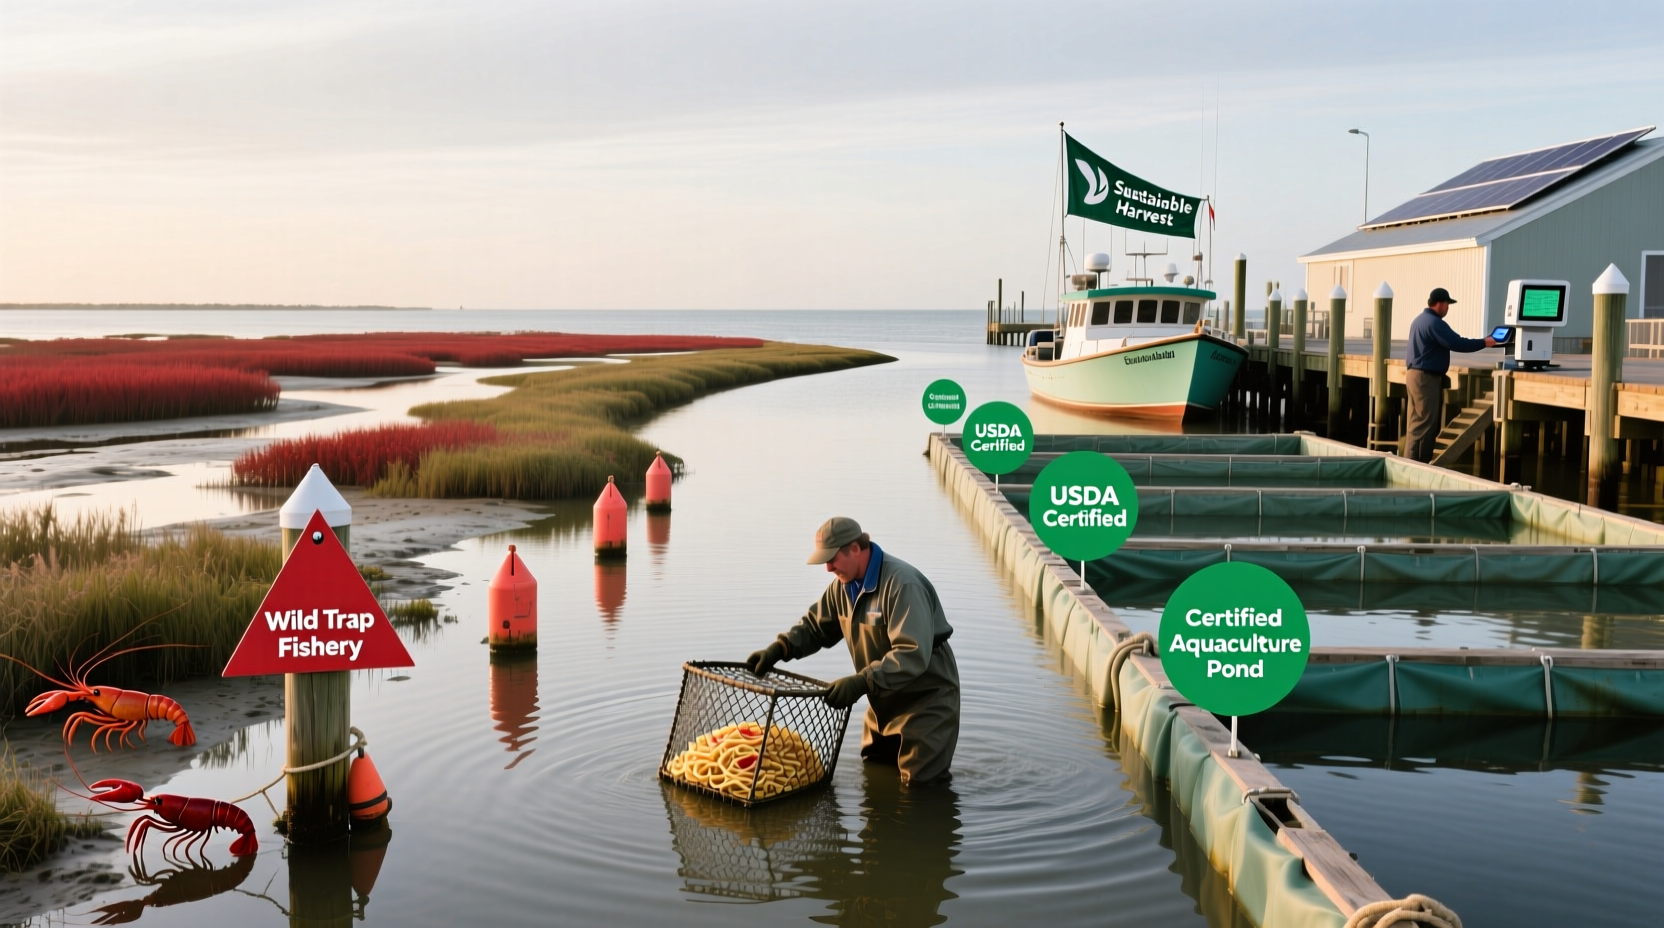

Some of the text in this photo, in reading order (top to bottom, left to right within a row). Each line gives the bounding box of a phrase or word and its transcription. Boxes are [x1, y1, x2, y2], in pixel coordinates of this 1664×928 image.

[1116, 199, 1174, 226] Harvest
[975, 423, 1022, 438] USDA
[1050, 485, 1119, 506] USDA
[1042, 508, 1127, 527] Certified
[265, 608, 374, 632] Wild Trap
[1185, 607, 1282, 627] Certified
[278, 636, 363, 661] Fishery
[1168, 633, 1302, 658] Aquaculture
[1206, 659, 1264, 678] Pond
